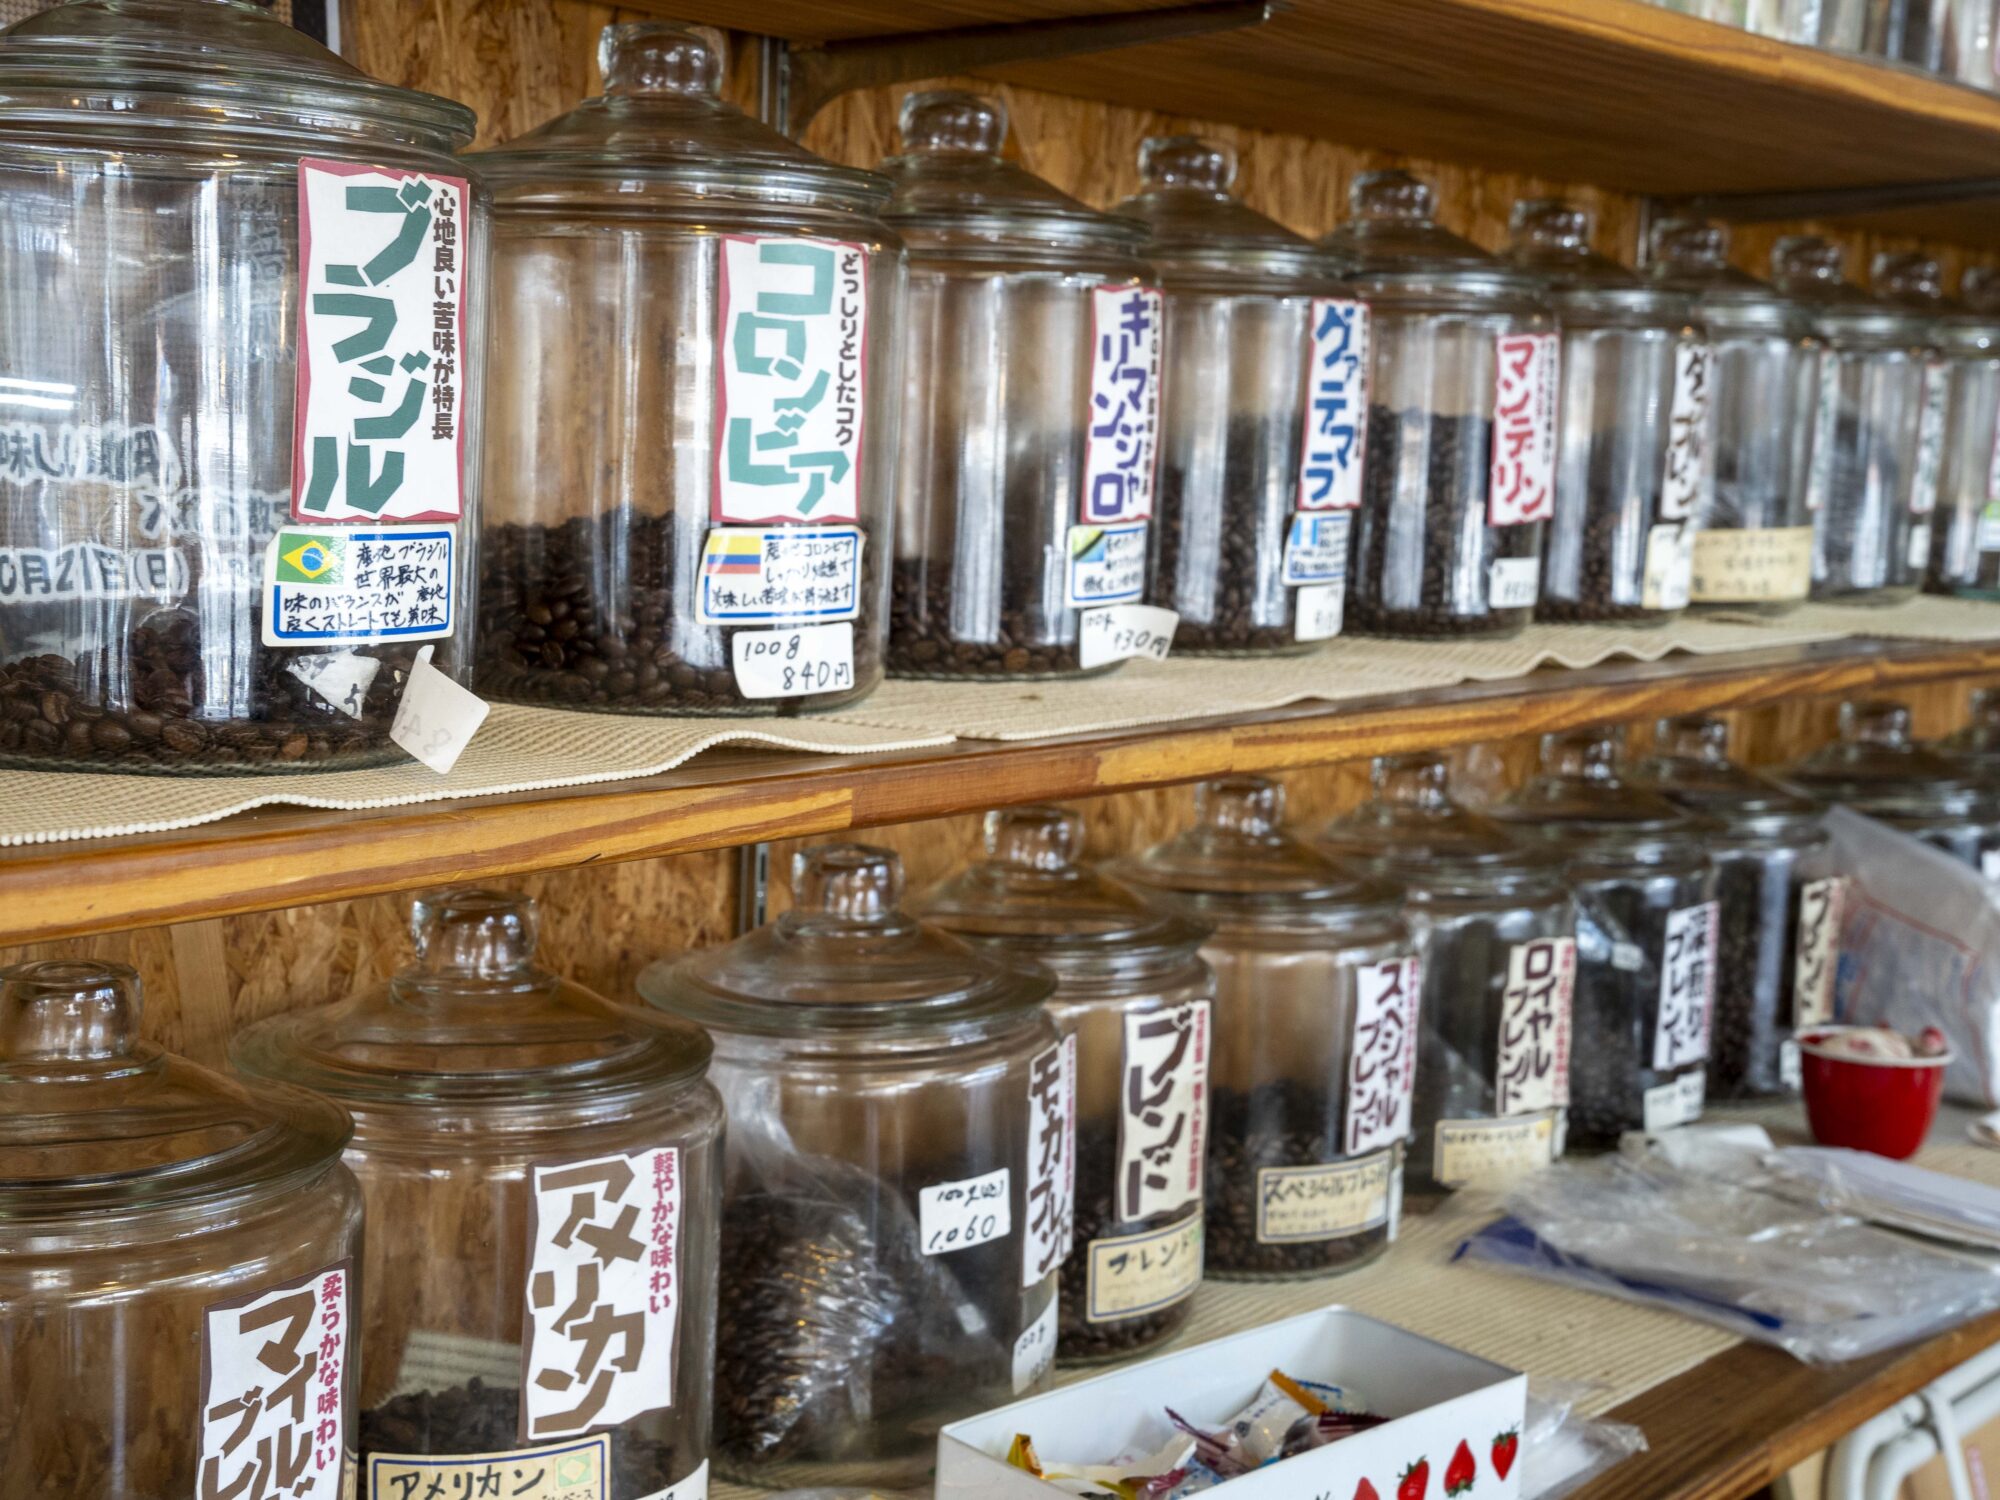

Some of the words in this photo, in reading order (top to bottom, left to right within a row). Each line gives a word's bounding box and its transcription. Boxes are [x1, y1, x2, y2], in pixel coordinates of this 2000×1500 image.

[304, 180, 433, 514] ブラジル
[432, 188, 456, 440] 心地良い苦味が特長
[727, 243, 851, 516] コロンビア
[835, 253, 860, 446] どっしりとしたコク
[1092, 293, 1150, 517] キリマンジャロ
[1497, 341, 1547, 516] マンデリン
[354, 564, 439, 590] 世界最大の
[782, 660, 851, 691] 840円
[1126, 1008, 1193, 1217] ブレンド
[1376, 963, 1404, 1129] スペシャル
[1516, 943, 1557, 1086] ロイヤル
[531, 1158, 648, 1435] アメリカン
[649, 1151, 674, 1315] 軽やかな味わい
[315, 1272, 343, 1471] 柔らかな味わい
